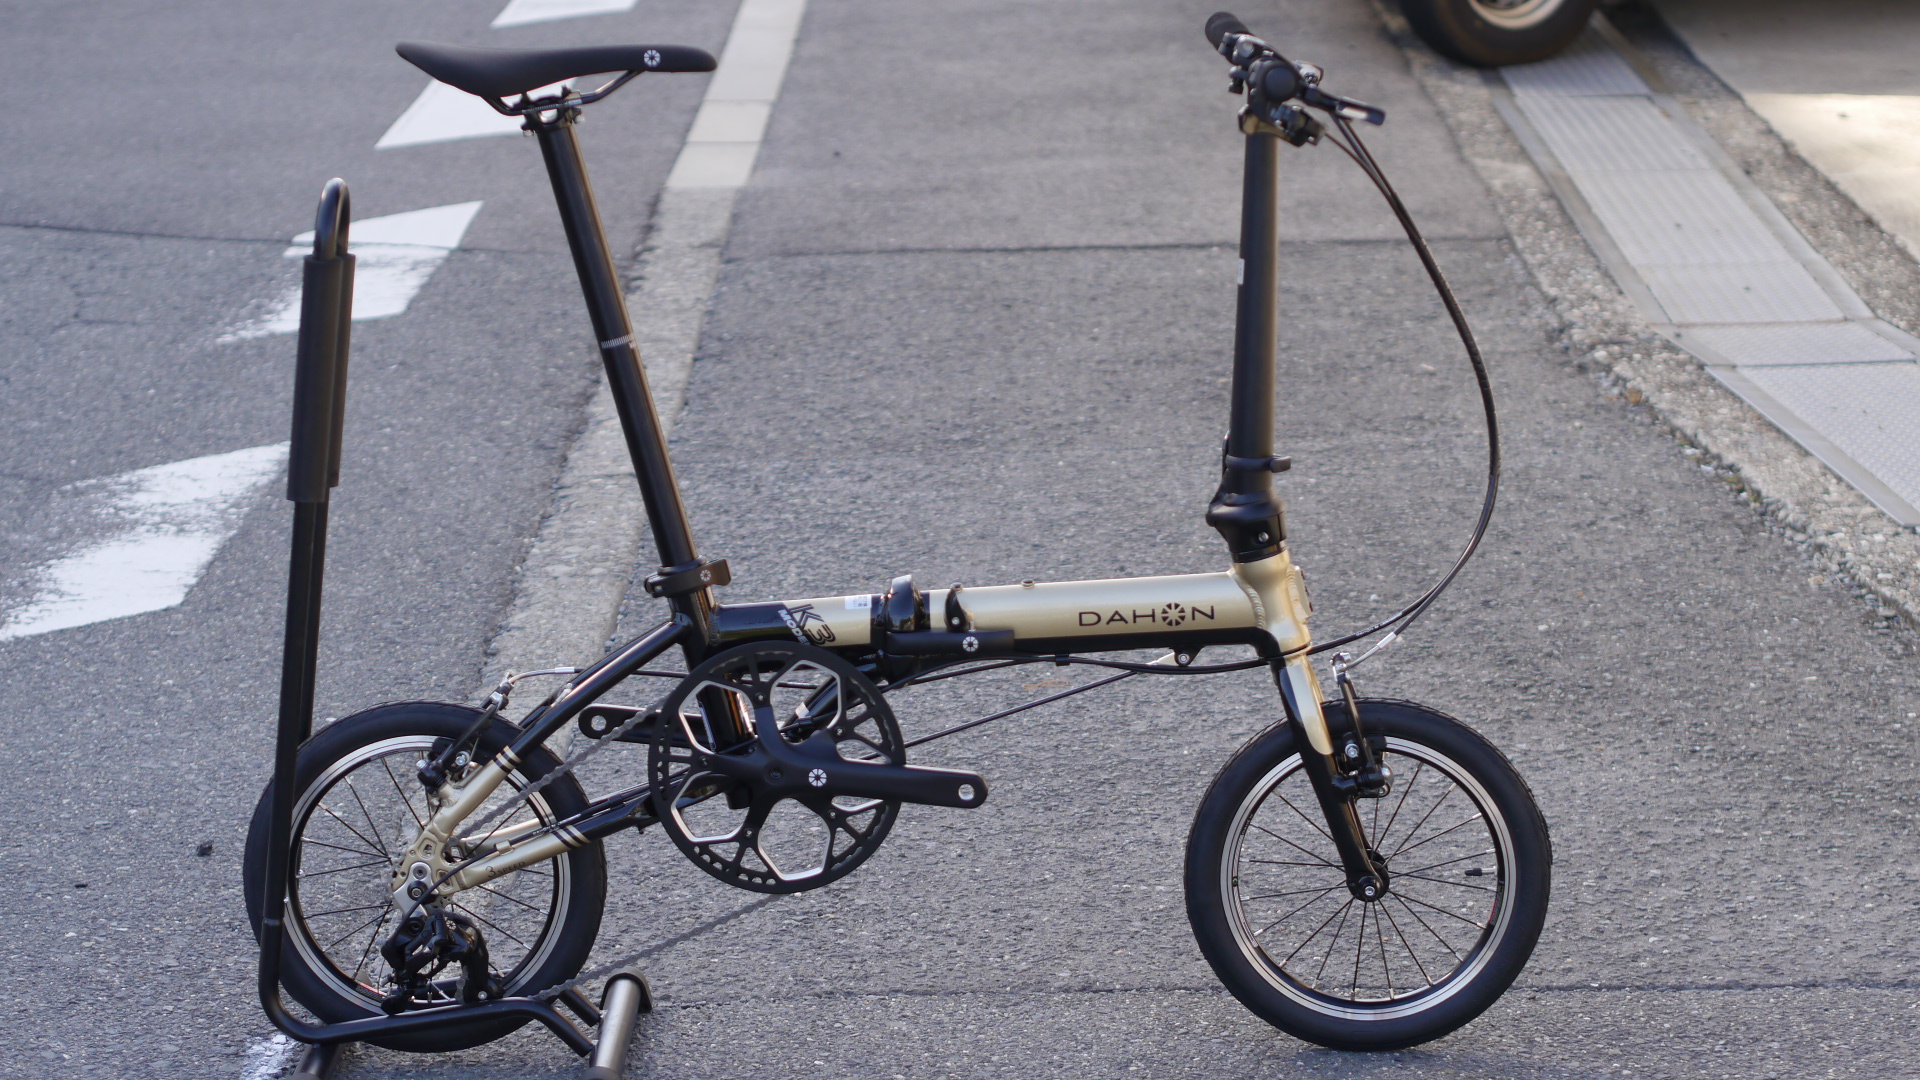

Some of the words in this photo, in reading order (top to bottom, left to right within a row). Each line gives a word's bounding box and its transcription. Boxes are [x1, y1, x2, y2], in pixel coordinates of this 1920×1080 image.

[788, 603, 836, 646] K3
[1079, 602, 1215, 627] DAHON
[485, 865, 496, 878] 3
